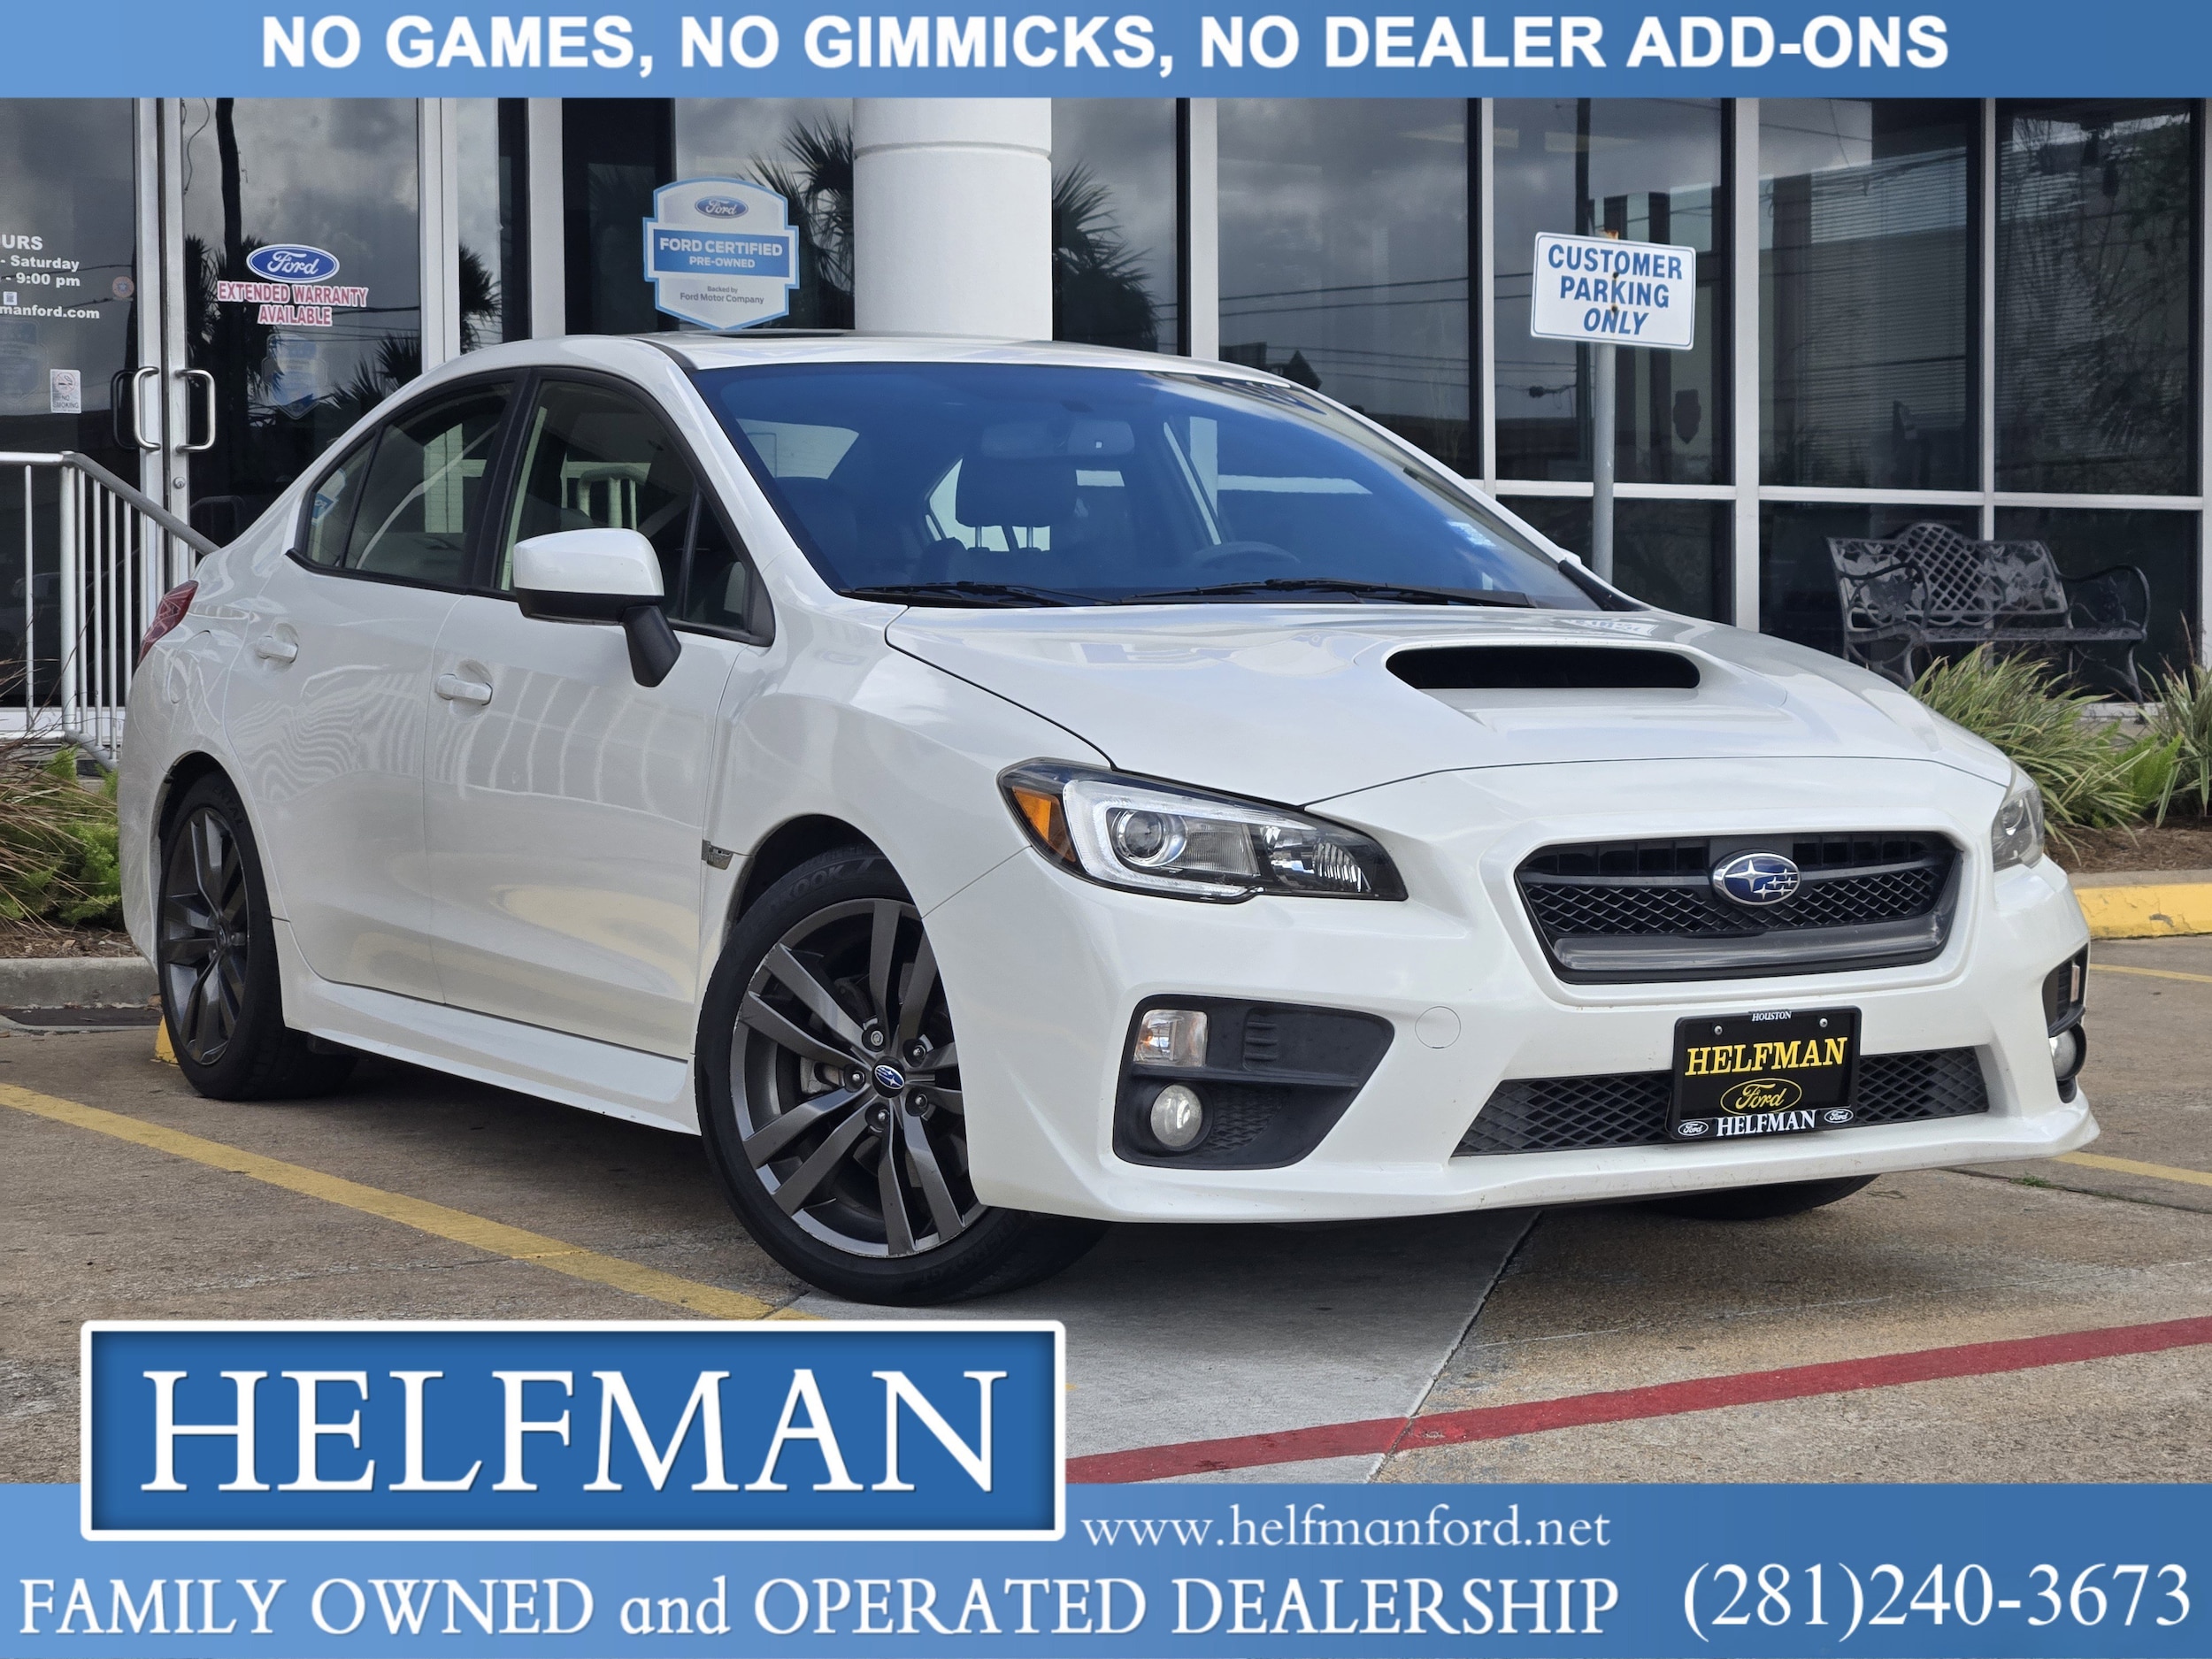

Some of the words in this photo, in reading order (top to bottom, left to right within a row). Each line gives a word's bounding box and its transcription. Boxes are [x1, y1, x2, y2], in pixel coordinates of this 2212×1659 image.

[705, 200, 737, 215] Ford
[0, 234, 43, 250] URS
[660, 237, 702, 252] FORD
[705, 240, 783, 256] CERTIFIED
[11, 255, 80, 272] Saturday
[266, 250, 319, 275] Ford
[689, 256, 756, 268] PRE-OWNED
[1548, 244, 1683, 280] CUSTOMER
[16, 273, 50, 285] 9:00
[56, 277, 81, 288] pm
[218, 281, 290, 303] EXTENDED
[292, 284, 369, 307] WARRANTY
[680, 292, 699, 301] Ford
[700, 293, 725, 302] Motor
[726, 295, 764, 304] Company
[1560, 275, 1670, 308] PARKING
[0, 305, 100, 319] manford.com
[257, 304, 333, 326] AVAILABLE
[1584, 308, 1649, 335] ONLY
[1752, 1010, 1793, 1021] HOUSTON
[1685, 1037, 1848, 1076] HELFMAN
[1735, 1083, 1787, 1110] Ford
[1716, 1110, 1818, 1137] HELFMAN
[1829, 1110, 1850, 1122] Ford
[1683, 1123, 1704, 1134] Ford
